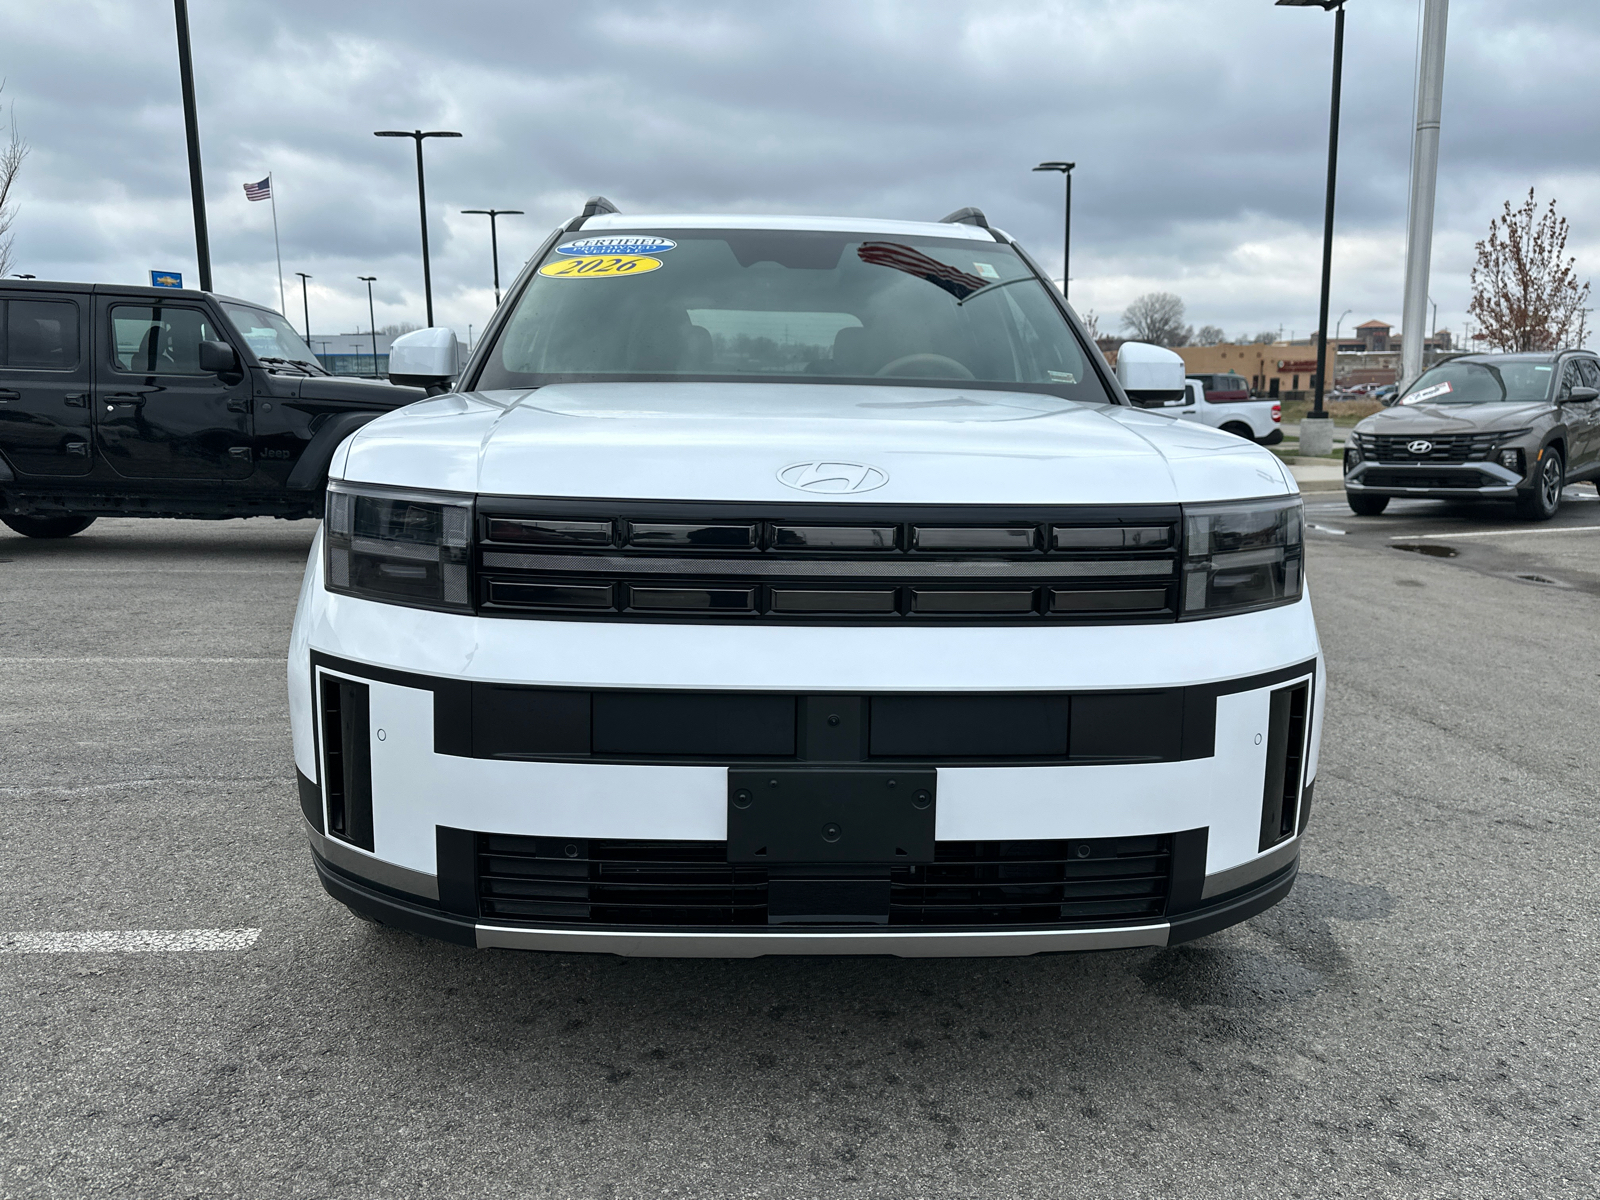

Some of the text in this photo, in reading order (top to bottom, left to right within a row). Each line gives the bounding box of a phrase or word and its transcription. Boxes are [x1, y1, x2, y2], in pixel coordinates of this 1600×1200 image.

[572, 238, 665, 246] CERTIFIED
[555, 258, 646, 275] 2026
[260, 447, 290, 459] Jeep
